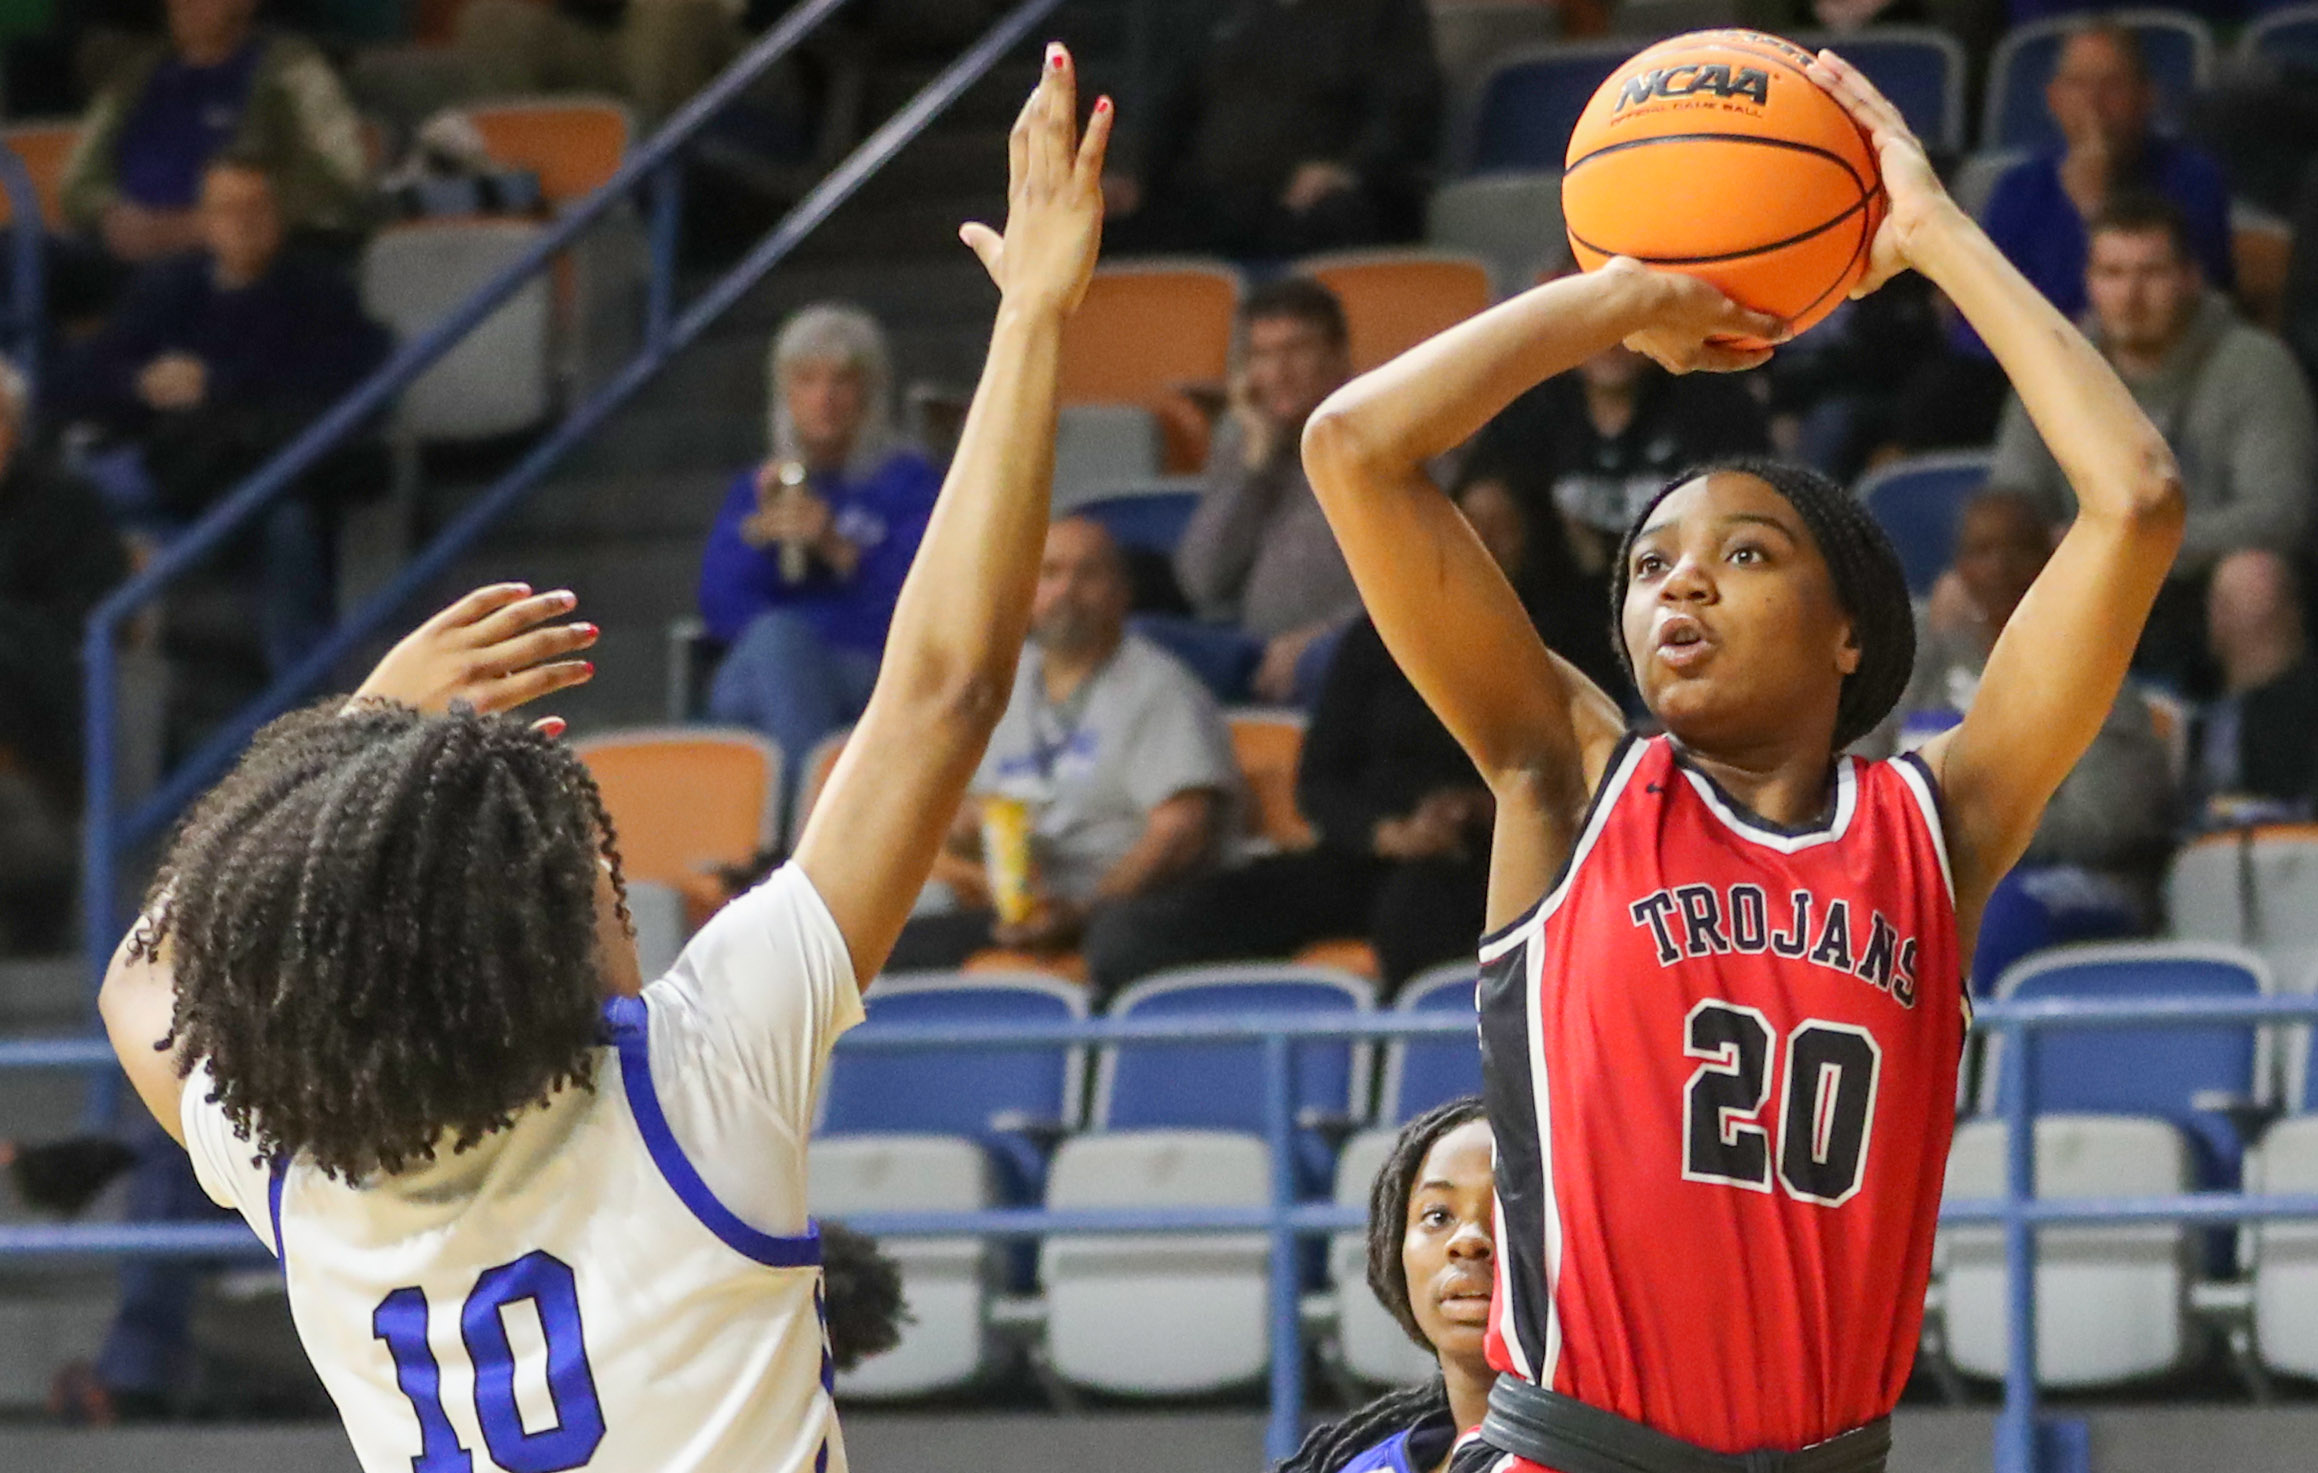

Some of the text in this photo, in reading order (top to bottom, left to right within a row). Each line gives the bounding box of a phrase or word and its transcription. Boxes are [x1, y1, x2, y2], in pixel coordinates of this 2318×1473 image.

[1614, 63, 1769, 113] NCAA
[1629, 882, 1917, 1009] TROJANS
[1682, 997, 1882, 1208] 20
[373, 1249, 607, 1473] 10
